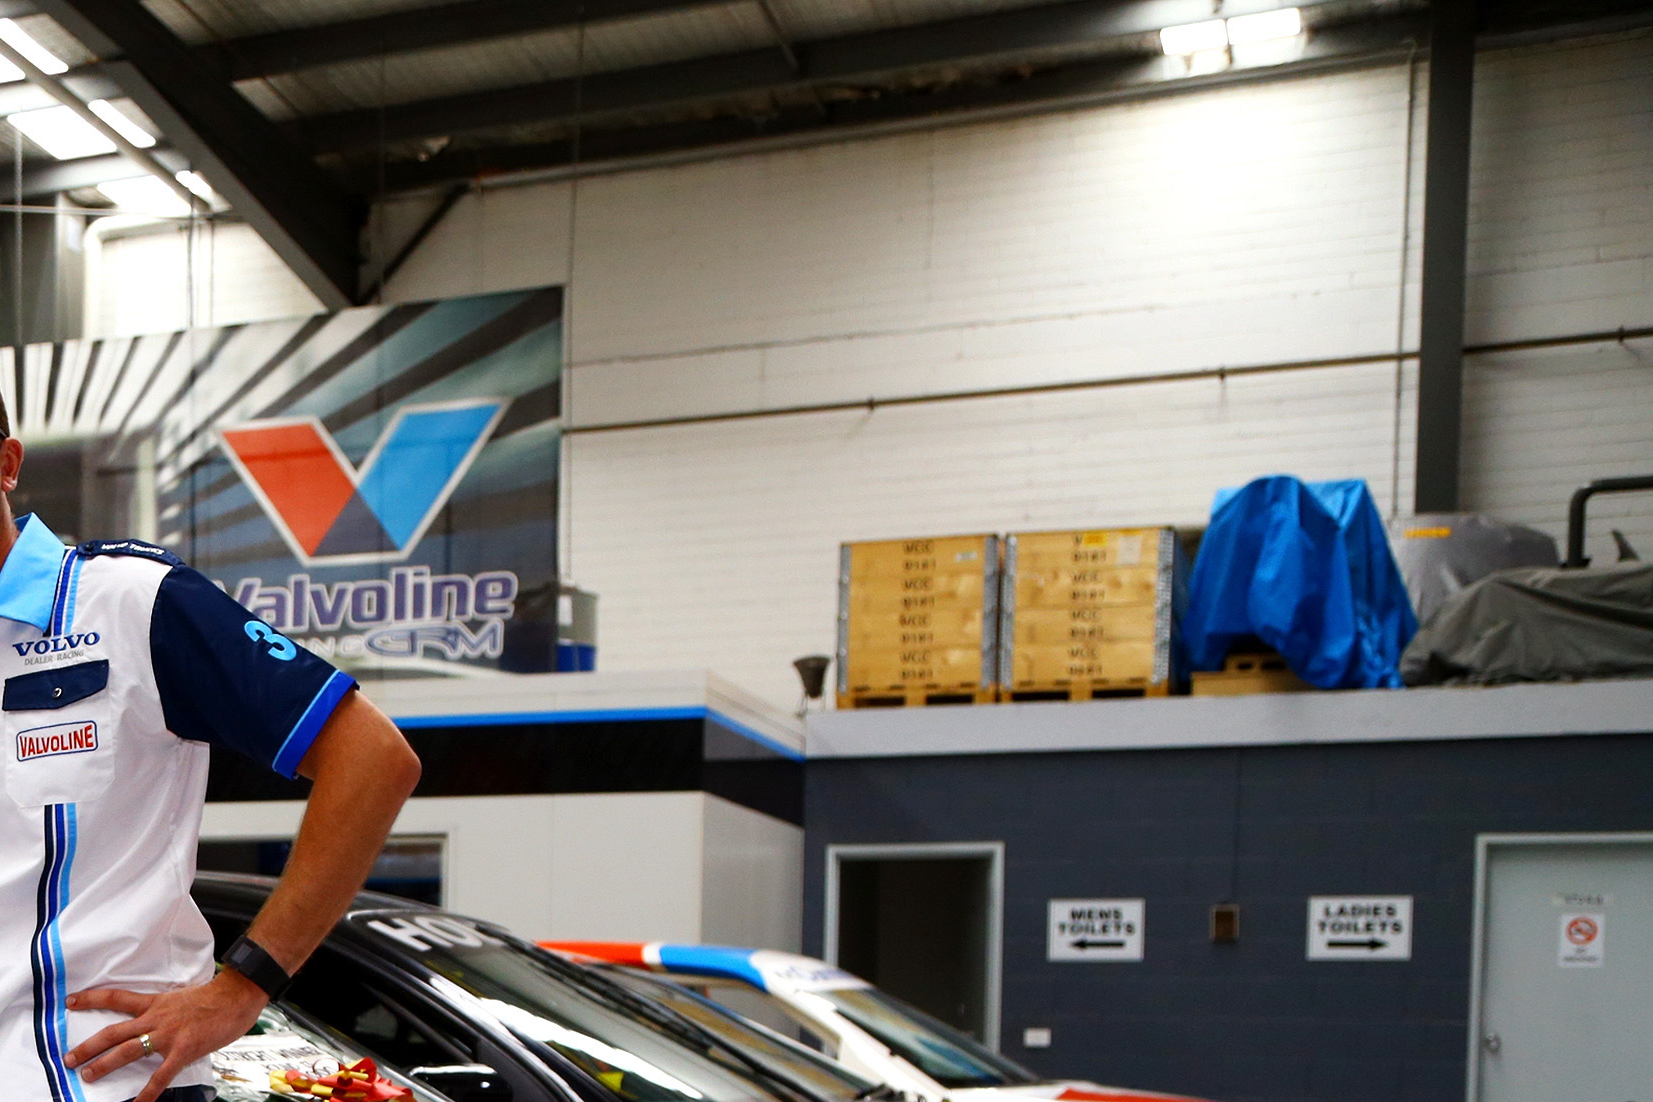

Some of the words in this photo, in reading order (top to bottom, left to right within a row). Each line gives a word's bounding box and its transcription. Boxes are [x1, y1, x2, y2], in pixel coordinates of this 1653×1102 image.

[12, 632, 101, 657] VOLVO
[24, 655, 54, 667] DEALER
[56, 650, 85, 662] RACING
[18, 723, 95, 759] VALVOLINE
[1069, 907, 1124, 922] MENS
[1322, 904, 1398, 919] LADIES
[1058, 922, 1136, 937] TOILETS
[1317, 921, 1403, 936] TOILETS
